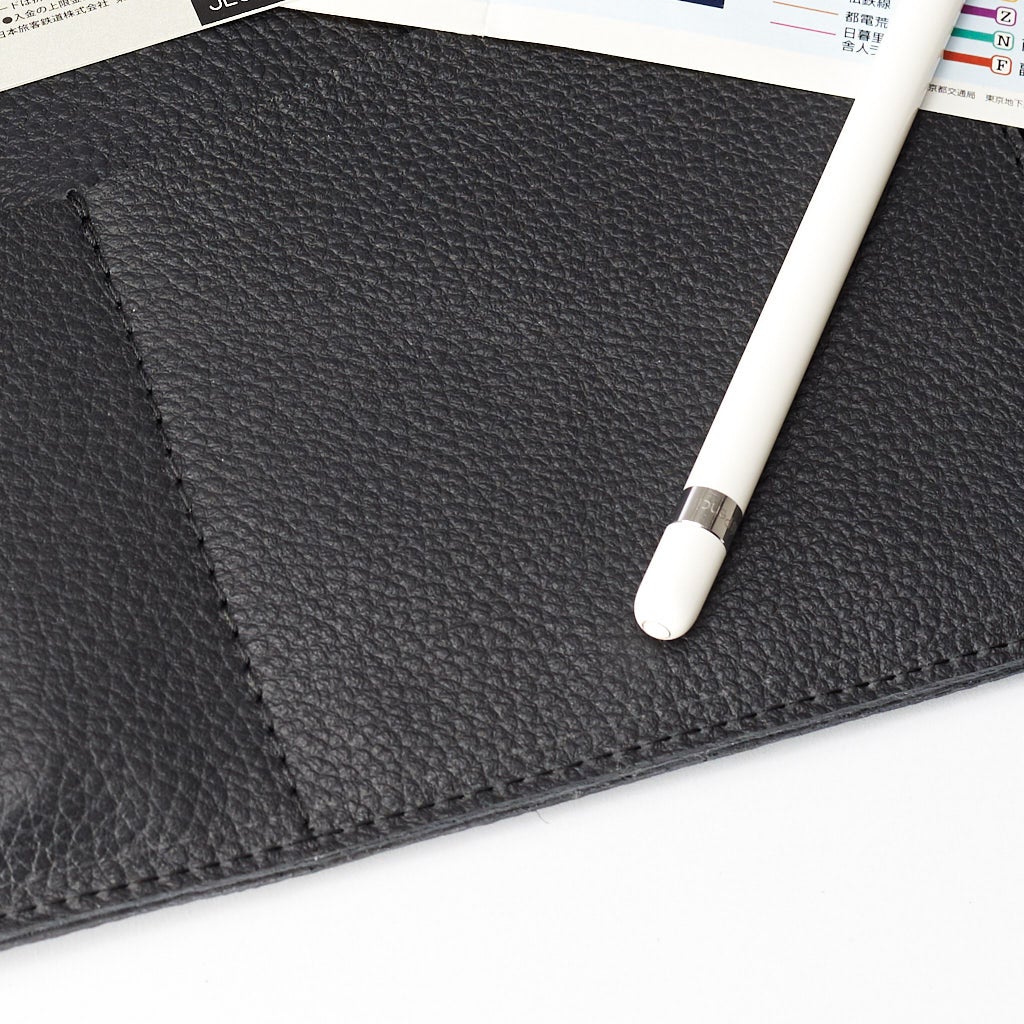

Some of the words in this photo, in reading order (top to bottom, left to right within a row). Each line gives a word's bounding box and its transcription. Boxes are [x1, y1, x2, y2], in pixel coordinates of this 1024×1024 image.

[1000, 11, 1011, 22] Z
[997, 35, 1010, 47] N
[997, 59, 1008, 71] F
